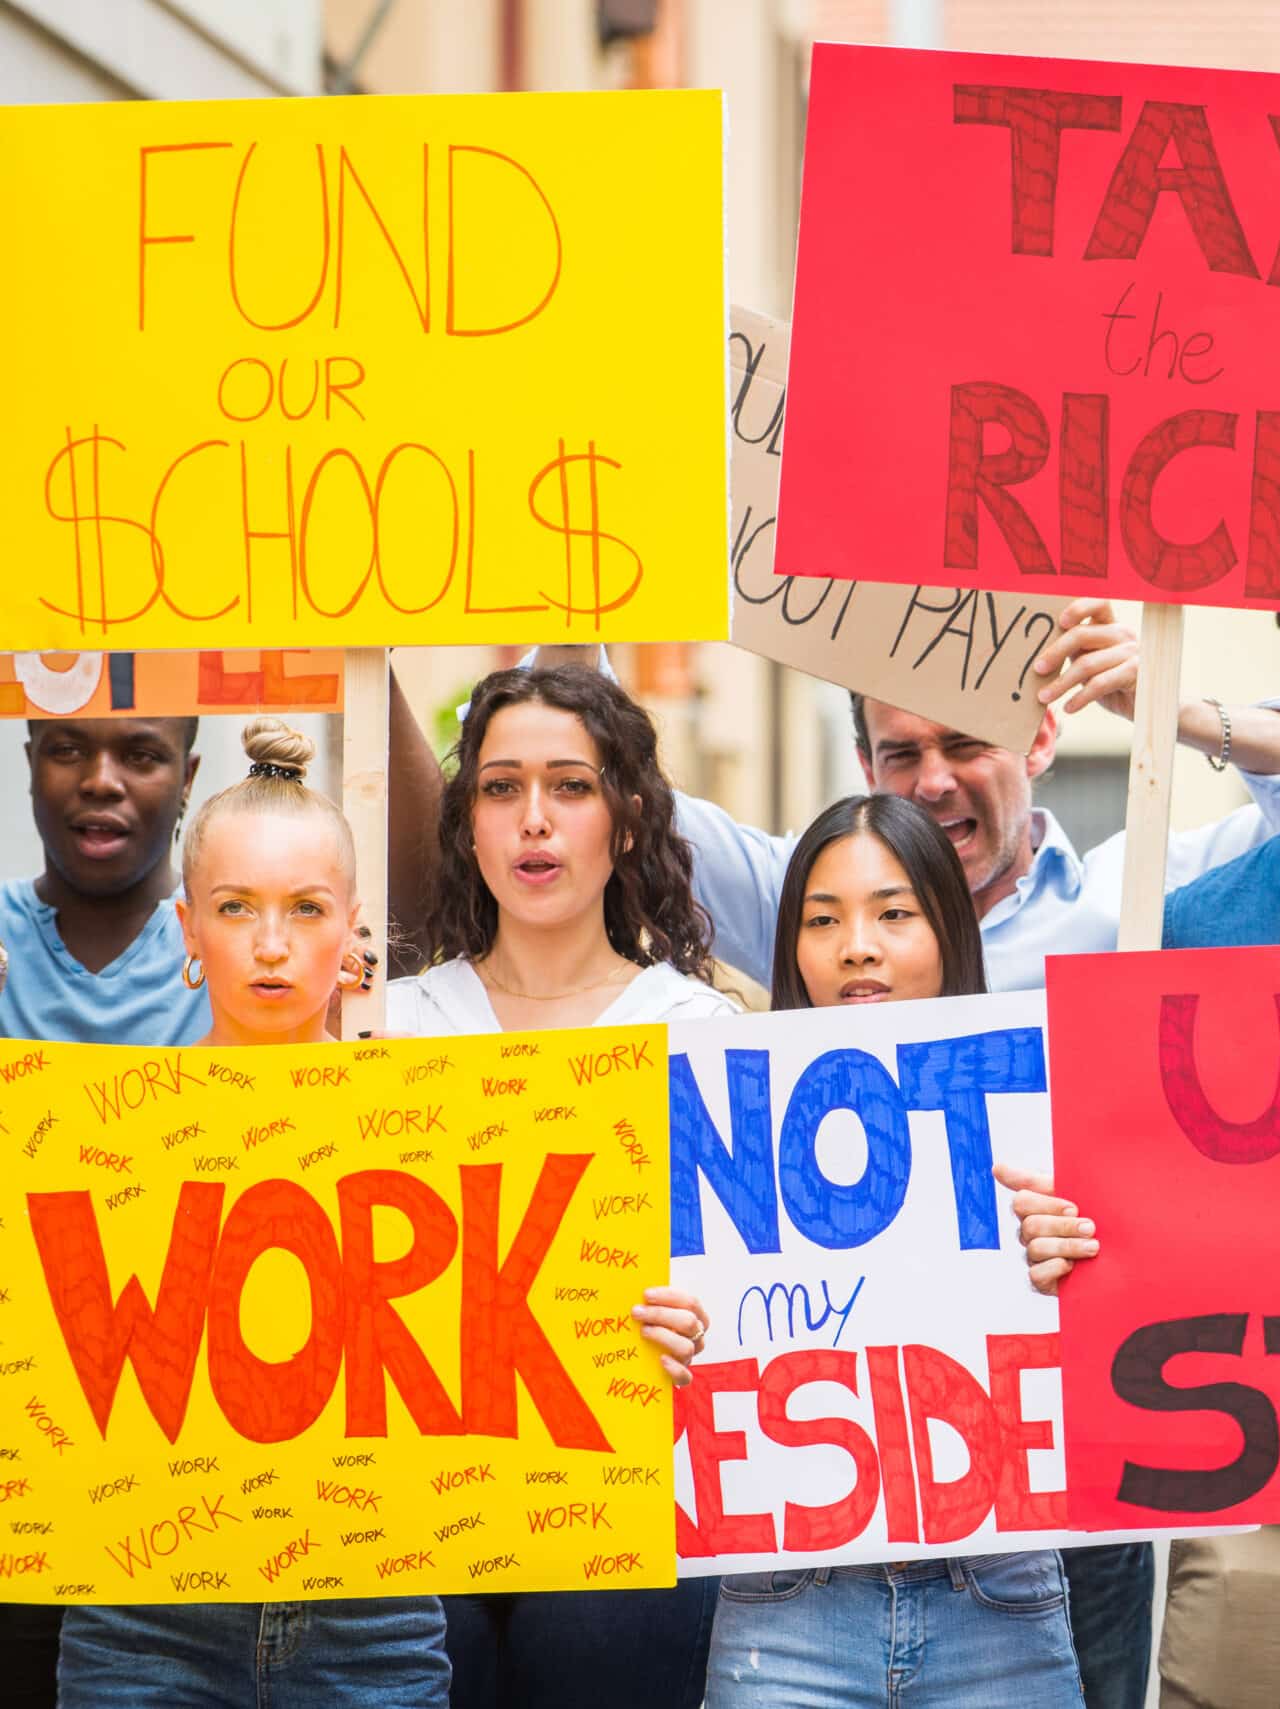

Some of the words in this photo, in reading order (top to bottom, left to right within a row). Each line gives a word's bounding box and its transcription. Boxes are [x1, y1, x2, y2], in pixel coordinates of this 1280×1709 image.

[139, 141, 563, 337] FUND
[1101, 282, 1225, 385] the
[217, 357, 366, 423] OUR
[38, 423, 643, 635] $CHOOL$
[889, 586, 1055, 702] PAY?
[0, 1048, 52, 1085] WORK
[353, 1047, 391, 1062] WORK
[501, 1043, 541, 1059] WORK
[568, 1040, 655, 1086] WORK
[208, 1062, 256, 1091] WORK
[289, 1065, 352, 1088] WORK
[403, 1055, 455, 1086] WORK
[83, 1051, 208, 1125] WORK
[481, 1076, 528, 1098] WORK
[357, 1104, 448, 1142] WORK
[533, 1106, 577, 1123] WORK
[22, 1109, 60, 1159] WORK
[161, 1121, 207, 1152] WORK
[241, 1116, 296, 1152] WORK
[466, 1120, 509, 1152] WORK
[612, 1118, 652, 1175] WORK
[669, 1027, 1047, 1258] NOT
[79, 1144, 134, 1176] WORK
[193, 1155, 240, 1172] WORK
[297, 1141, 339, 1172] WORK
[399, 1149, 434, 1165] WORK
[104, 1182, 147, 1211] WORK
[592, 1192, 653, 1221] WORK
[579, 1239, 640, 1270] WORK
[24, 1152, 617, 1453] WORK
[554, 1287, 599, 1302] WORK
[574, 1315, 630, 1339] WORK
[592, 1346, 638, 1368] WORK
[606, 1377, 662, 1408] WORK
[24, 1395, 75, 1456] WORK
[332, 1452, 376, 1468] WORK
[673, 1332, 1068, 1558] ESIDE
[168, 1456, 220, 1478] WORK
[240, 1468, 280, 1496] WORK
[430, 1464, 496, 1496] WORK
[525, 1470, 568, 1486] WORK
[601, 1465, 660, 1486] WORK
[88, 1474, 141, 1504] WORK
[316, 1480, 383, 1513] WORK
[251, 1505, 294, 1520] WORK
[433, 1512, 486, 1543] WORK
[526, 1502, 613, 1535] WORK
[9, 1521, 54, 1536] WORK
[104, 1494, 243, 1579] WORK
[339, 1528, 386, 1547] WORK
[258, 1528, 322, 1584] WORK
[376, 1550, 437, 1580] WORK
[468, 1553, 520, 1579] WORK
[582, 1552, 644, 1581] WORK
[53, 1584, 96, 1596] WORK
[170, 1571, 231, 1592] WORK
[302, 1576, 344, 1592] WORK
